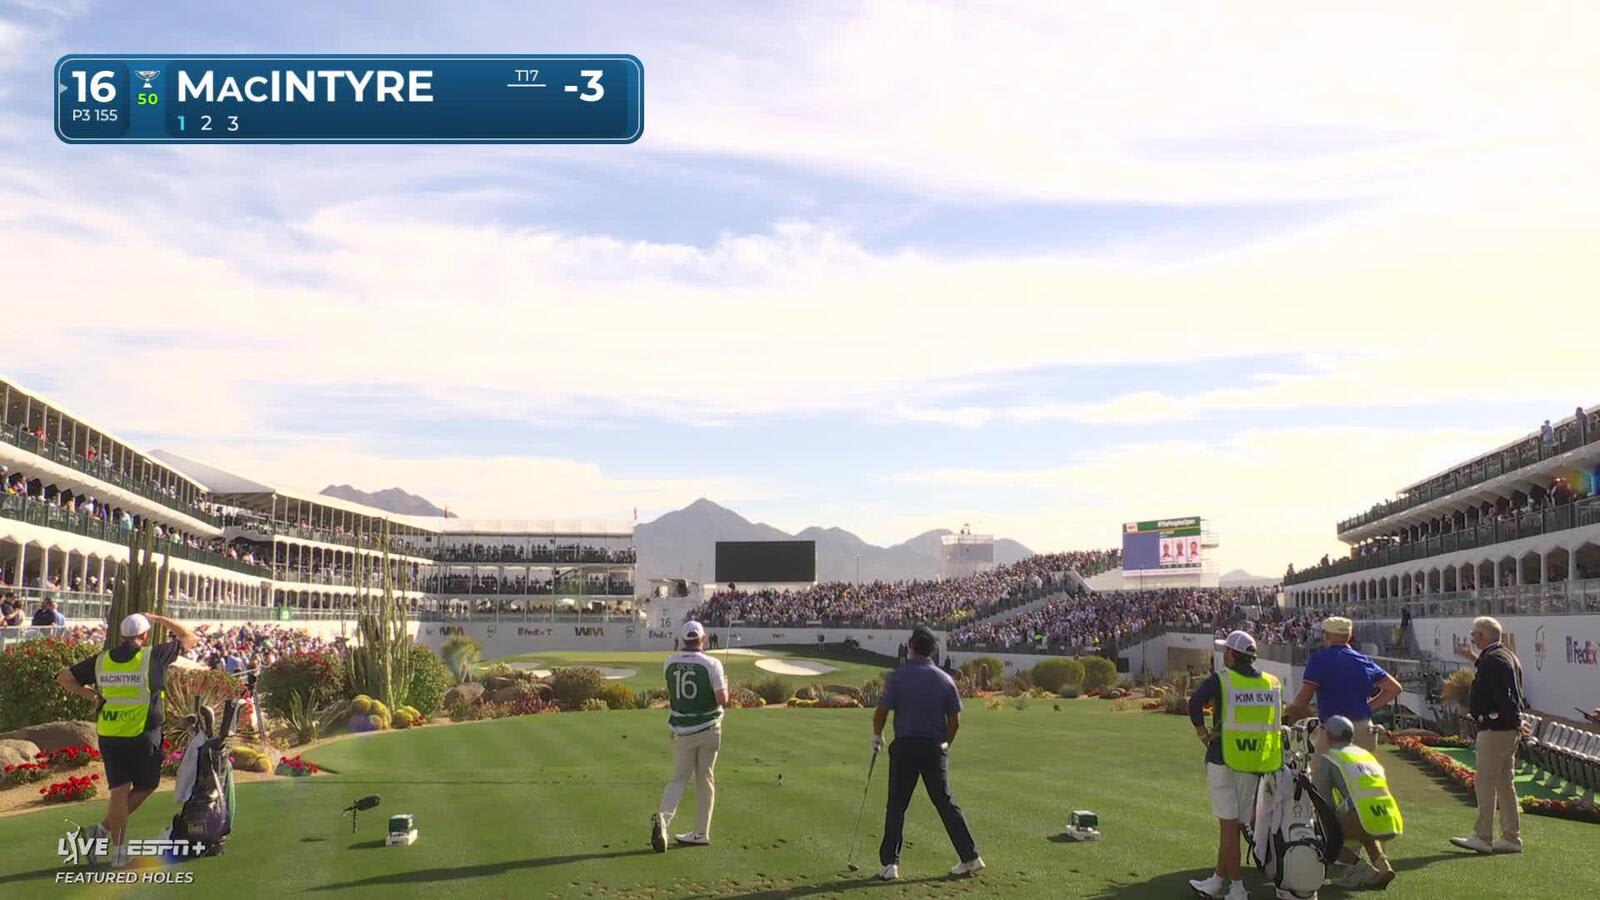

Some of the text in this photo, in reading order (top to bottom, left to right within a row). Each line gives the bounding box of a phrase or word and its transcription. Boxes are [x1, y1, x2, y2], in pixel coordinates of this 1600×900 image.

[1573, 639, 1598, 665] FedEx
[100, 674, 142, 684] MACINTYRE
[673, 670, 698, 700] 16
[1235, 693, 1254, 703] KIM
